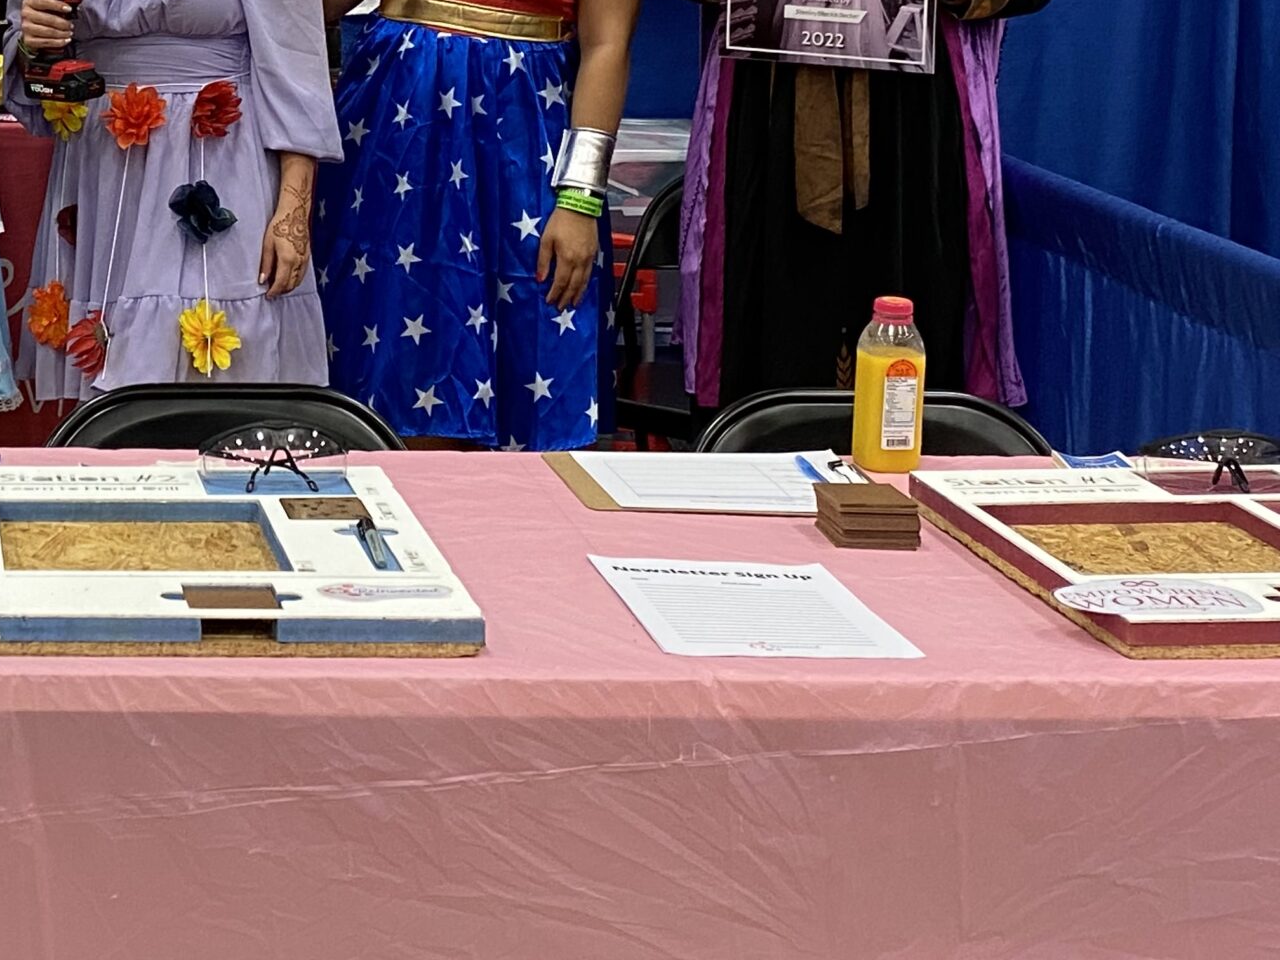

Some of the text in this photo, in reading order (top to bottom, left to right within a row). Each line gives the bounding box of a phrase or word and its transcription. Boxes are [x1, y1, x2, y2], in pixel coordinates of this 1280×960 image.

[801, 30, 845, 48] 2022
[0, 474, 119, 482] Station
[943, 477, 1067, 487] Station
[612, 565, 814, 582] Newsletter Sign Up
[1060, 588, 1234, 600] EMPOWERING
[1066, 595, 1248, 609] WOMEN
